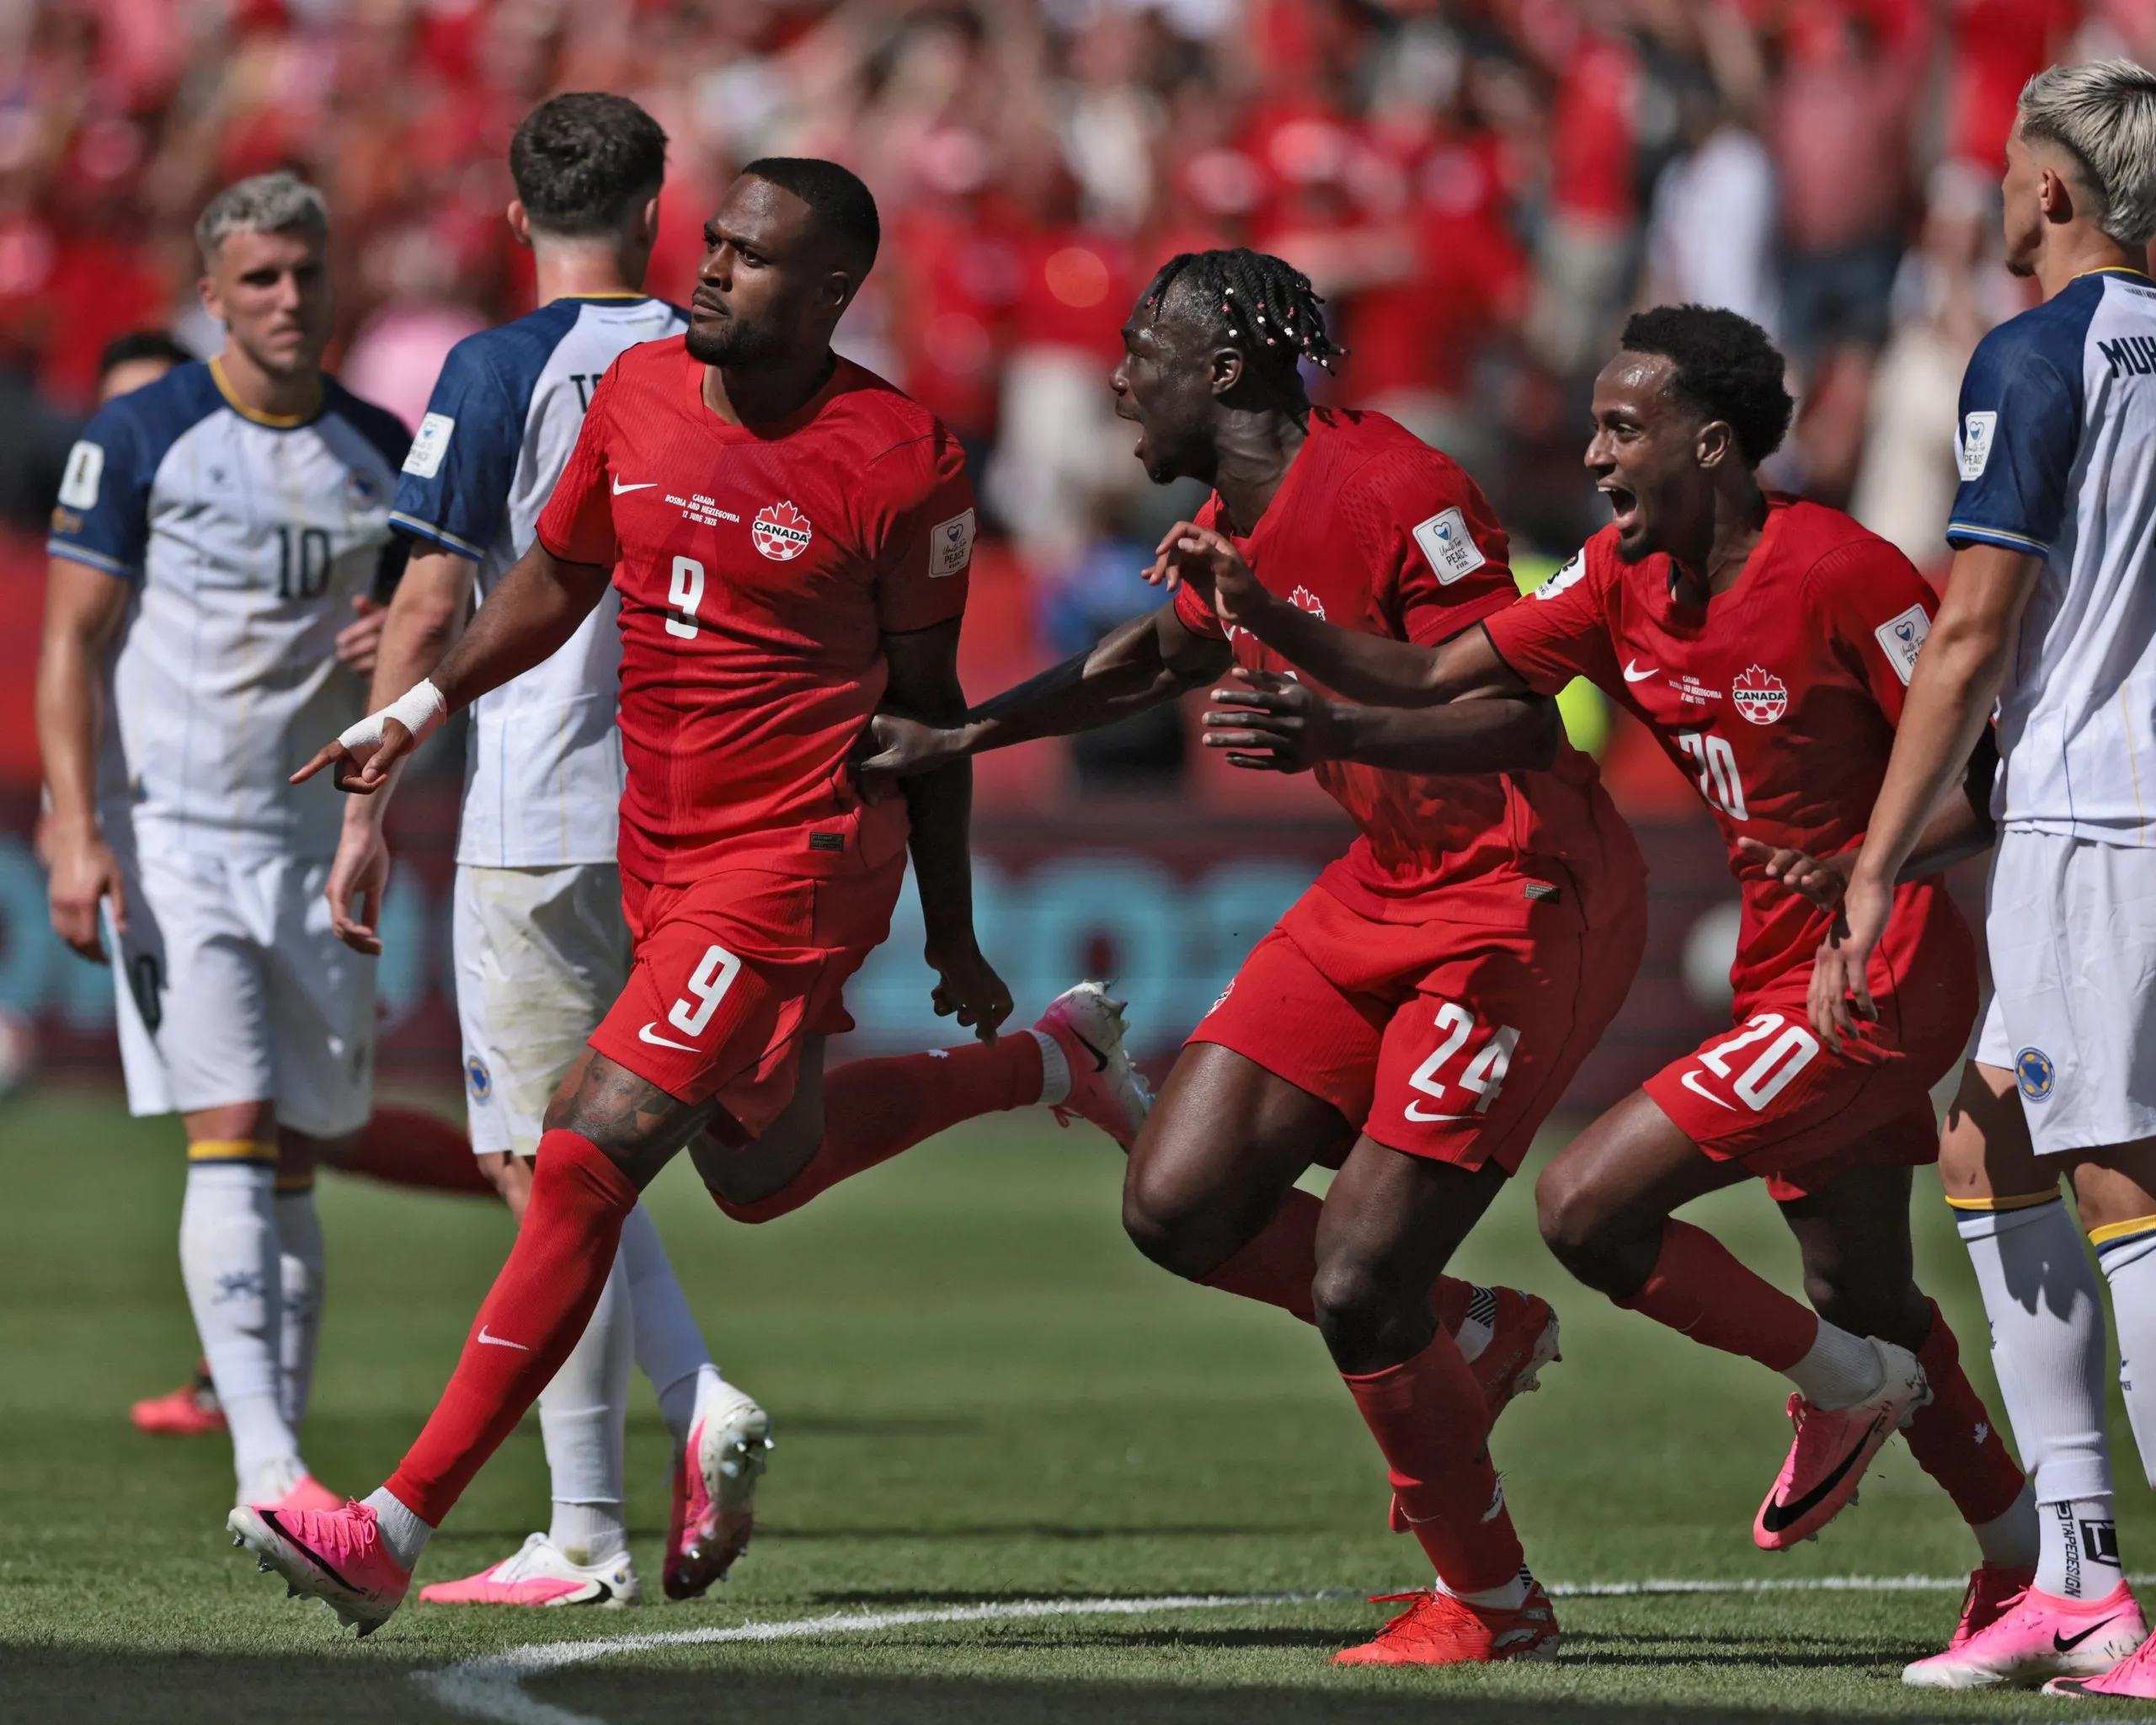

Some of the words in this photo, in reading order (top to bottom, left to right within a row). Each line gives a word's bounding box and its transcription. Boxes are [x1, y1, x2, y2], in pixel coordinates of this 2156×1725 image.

[664, 494, 686, 507] BOSNIA
[687, 501, 700, 510] AND
[701, 505, 740, 523] HERZEGOVINA
[692, 494, 715, 506] CANADA
[689, 513, 703, 522] JUNE
[754, 521, 808, 543] CANADA
[276, 525, 331, 601] 10
[944, 547, 964, 564] PEACE
[1445, 547, 1468, 566] PEACE
[1455, 560, 1469, 570] FIFA
[665, 556, 705, 640] 9
[1734, 691, 1785, 701] CANADA
[668, 944, 741, 1037] 9
[1408, 1002, 1522, 1114] 24
[1697, 1013, 1820, 1103] 20
[2062, 1521, 2081, 1599] TAPEDESIGN
